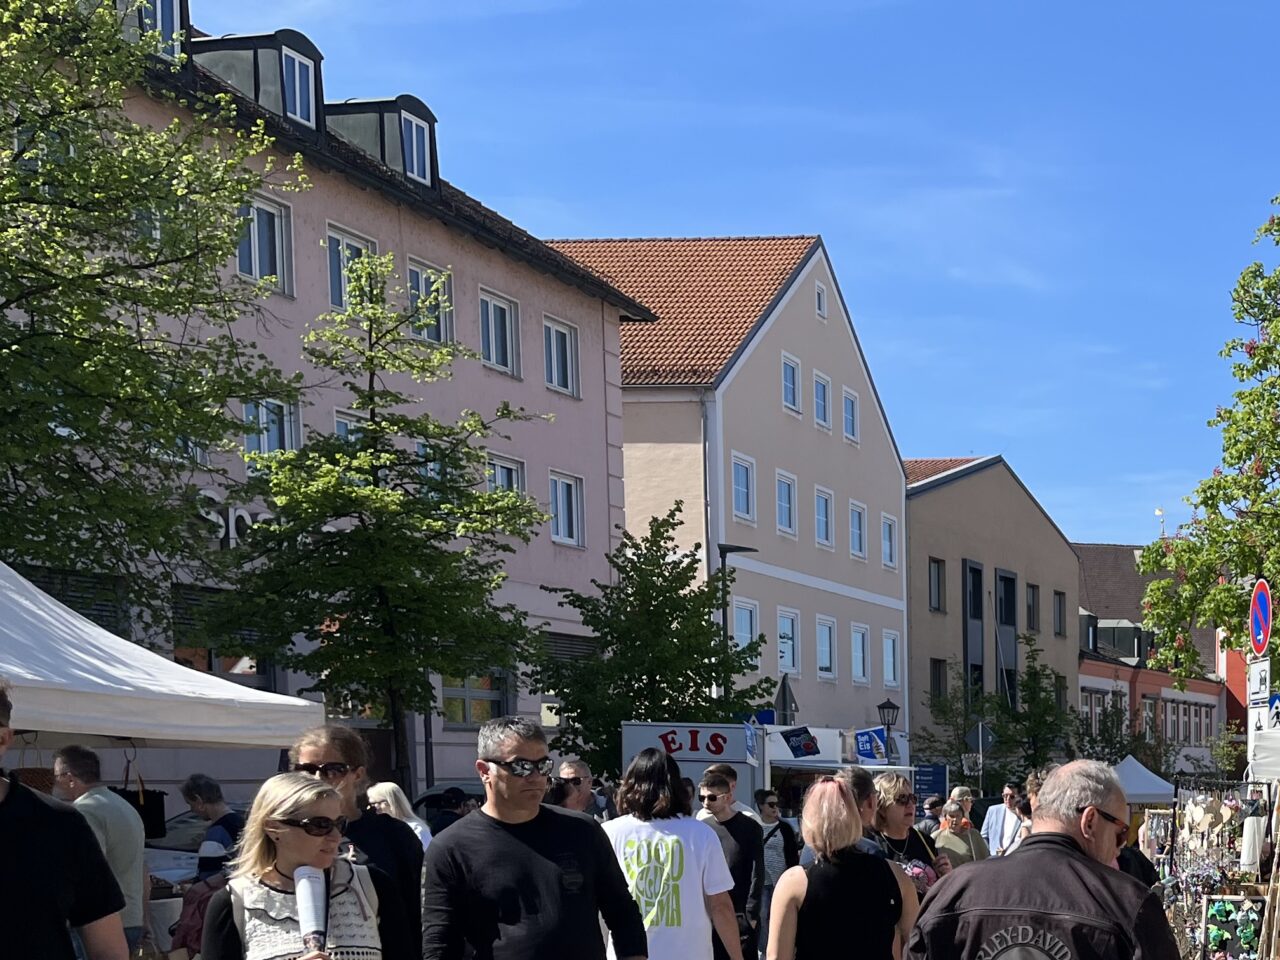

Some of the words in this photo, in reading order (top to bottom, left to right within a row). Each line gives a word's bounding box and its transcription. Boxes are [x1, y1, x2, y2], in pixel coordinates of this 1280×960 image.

[658, 729, 728, 755] EIS
[857, 734, 870, 743] Soft
[858, 742, 871, 750] Eis
